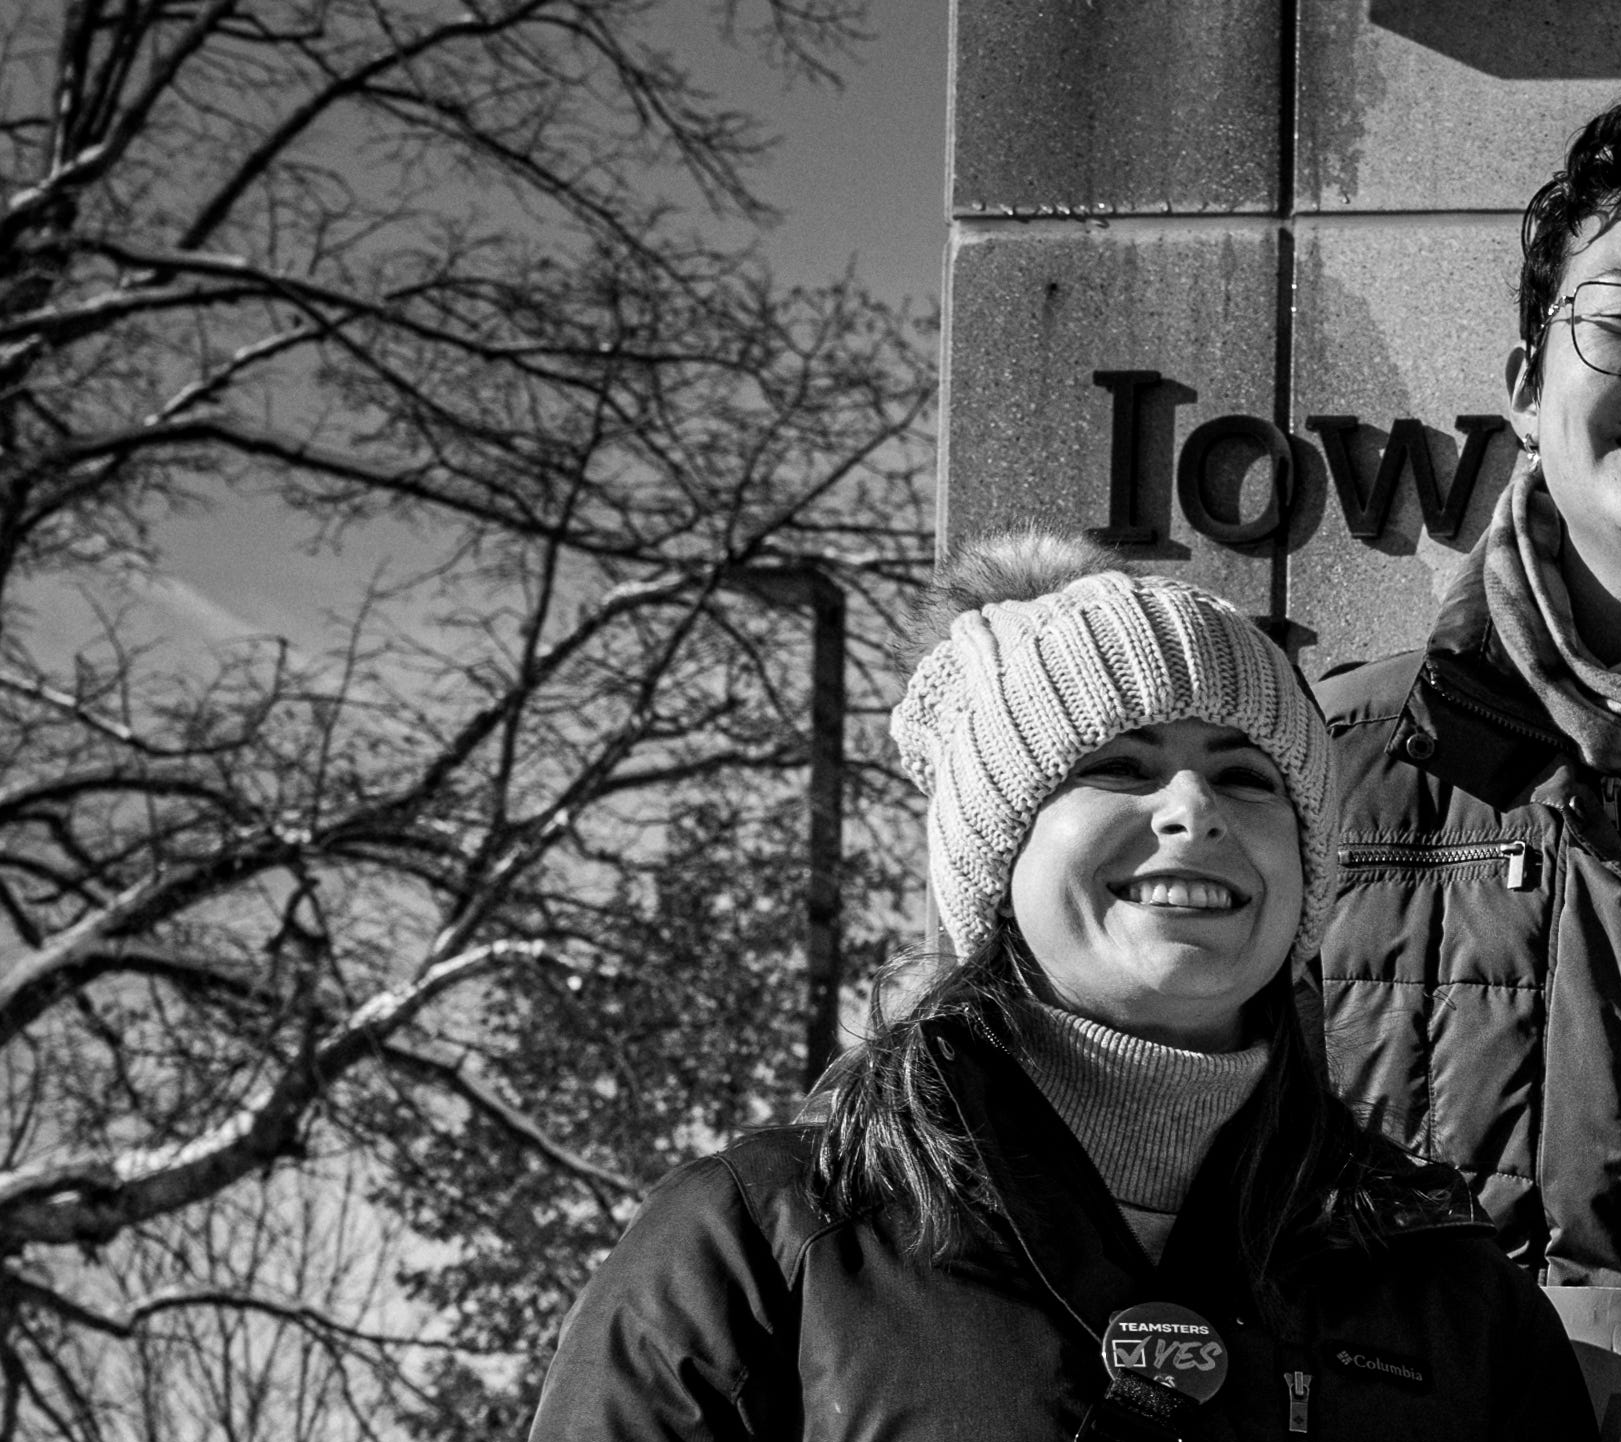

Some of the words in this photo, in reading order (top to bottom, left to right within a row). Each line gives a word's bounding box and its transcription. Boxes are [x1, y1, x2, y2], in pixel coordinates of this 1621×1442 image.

[1090, 368, 1508, 546] Iow
[1118, 1322, 1209, 1335] TEAMSTERS
[1153, 1337, 1223, 1372] YES
[1354, 1354, 1424, 1382] Columbia
